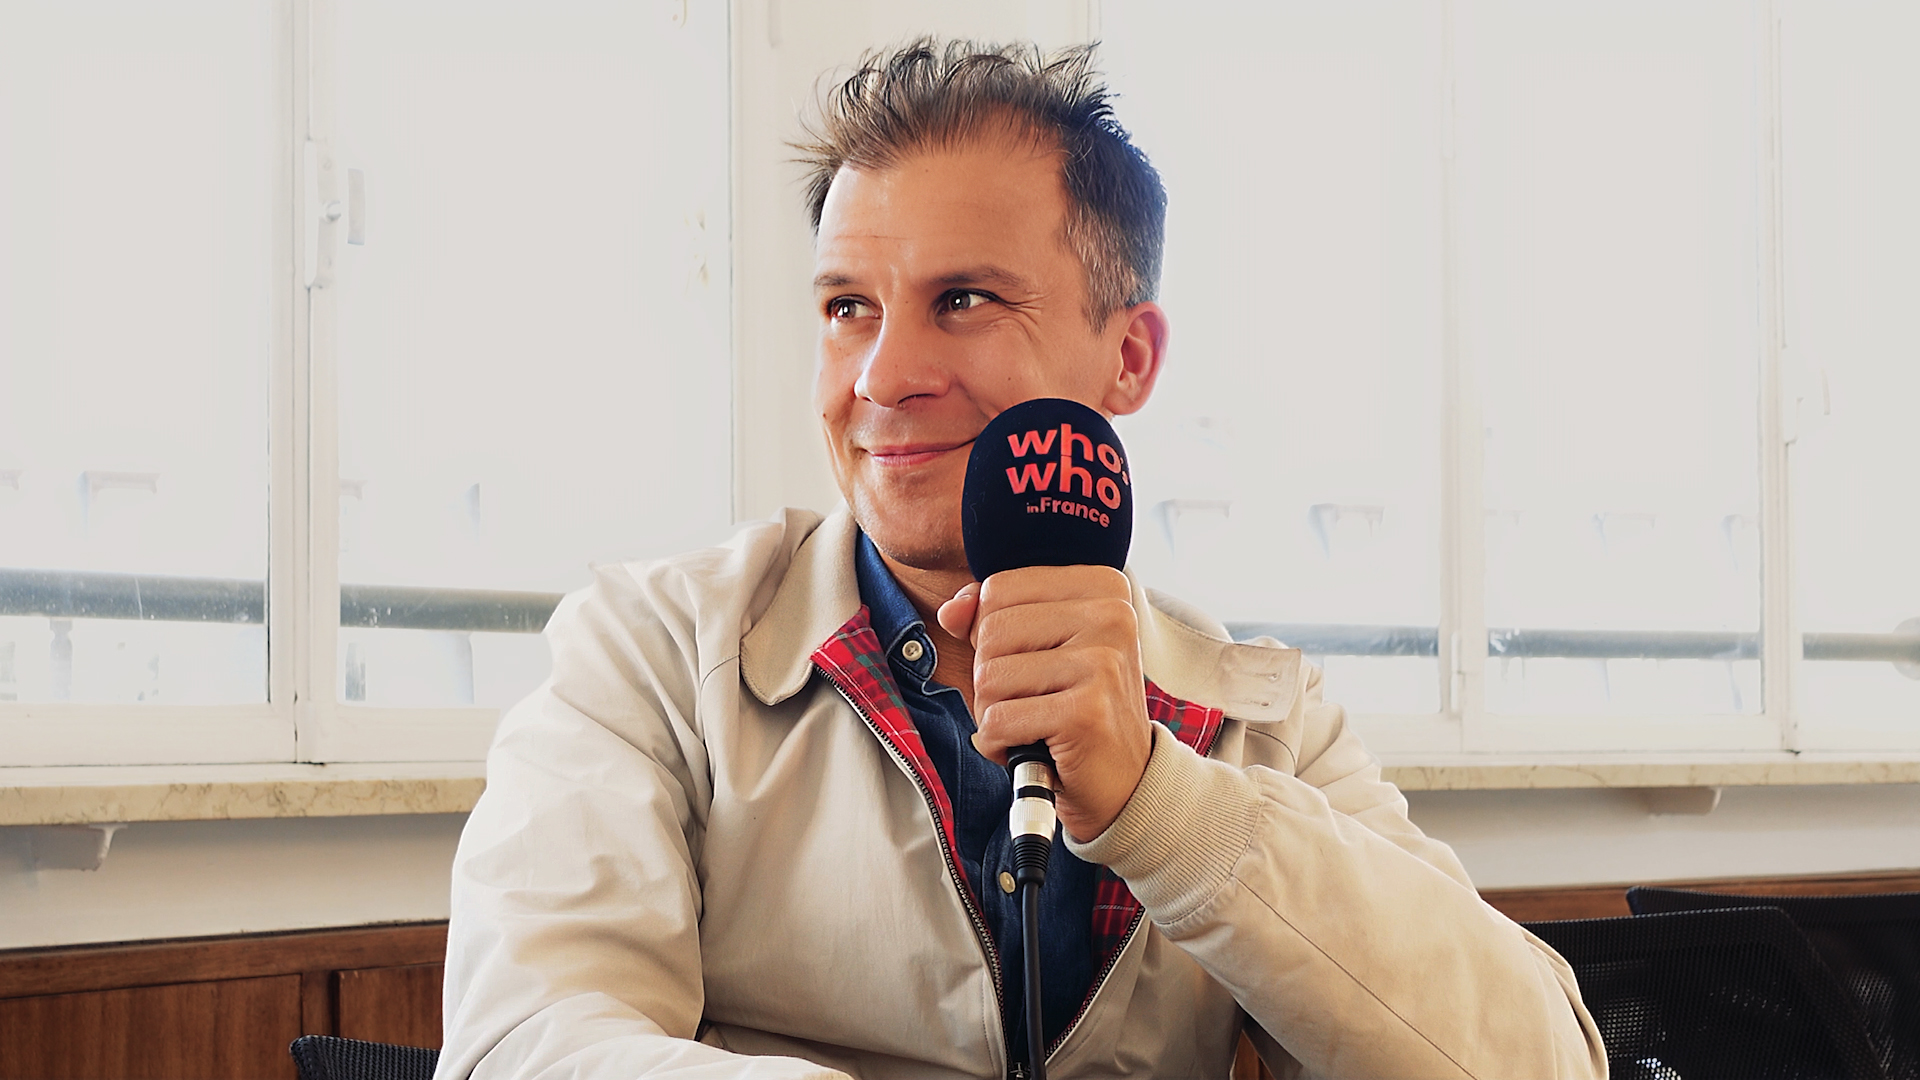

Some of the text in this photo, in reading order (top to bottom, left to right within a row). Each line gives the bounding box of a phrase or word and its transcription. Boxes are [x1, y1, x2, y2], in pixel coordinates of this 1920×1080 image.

[1006, 457, 1121, 510] who
[1027, 497, 1110, 527] in France
